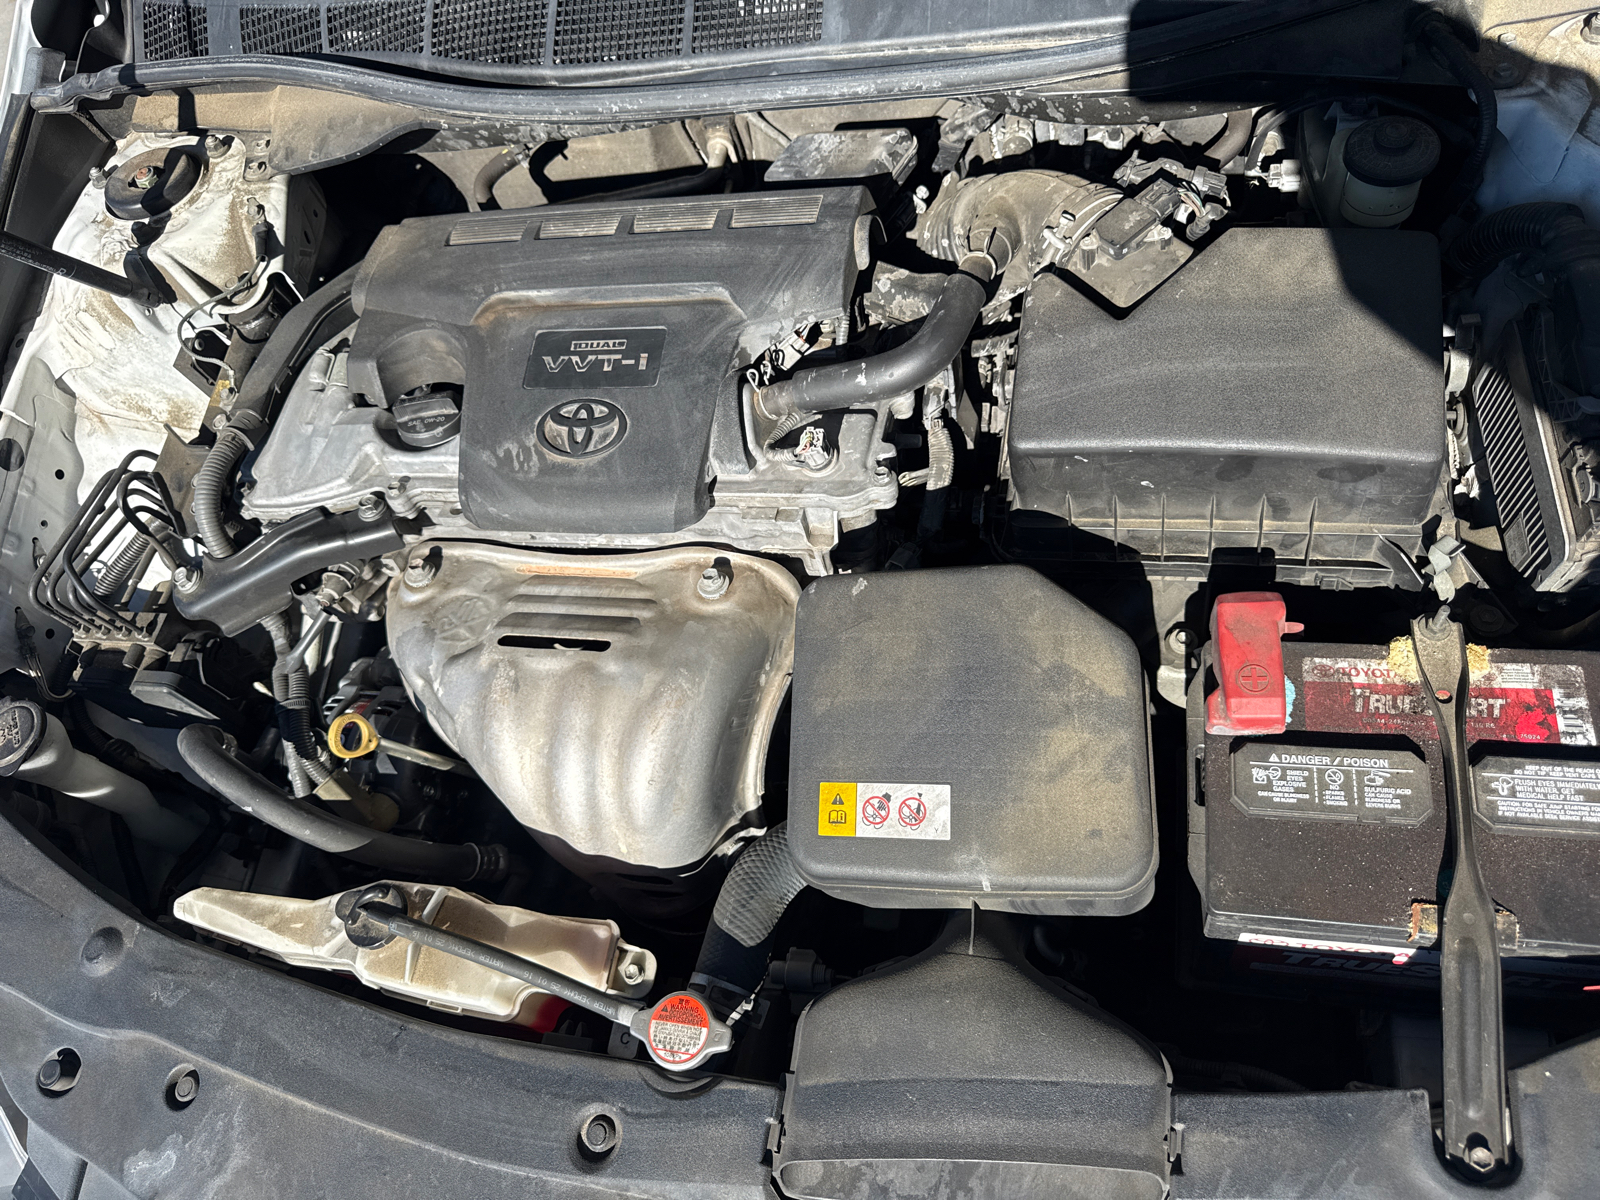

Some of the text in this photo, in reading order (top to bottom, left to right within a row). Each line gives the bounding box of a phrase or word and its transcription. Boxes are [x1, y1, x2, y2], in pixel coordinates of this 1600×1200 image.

[1339, 666, 1399, 678] TOYOT
[1282, 754, 1330, 765] DANGER
[1344, 758, 1388, 768] POISON
[670, 1003, 699, 1013] WARNING
[658, 1014, 702, 1026] AVERTISSEMENT
